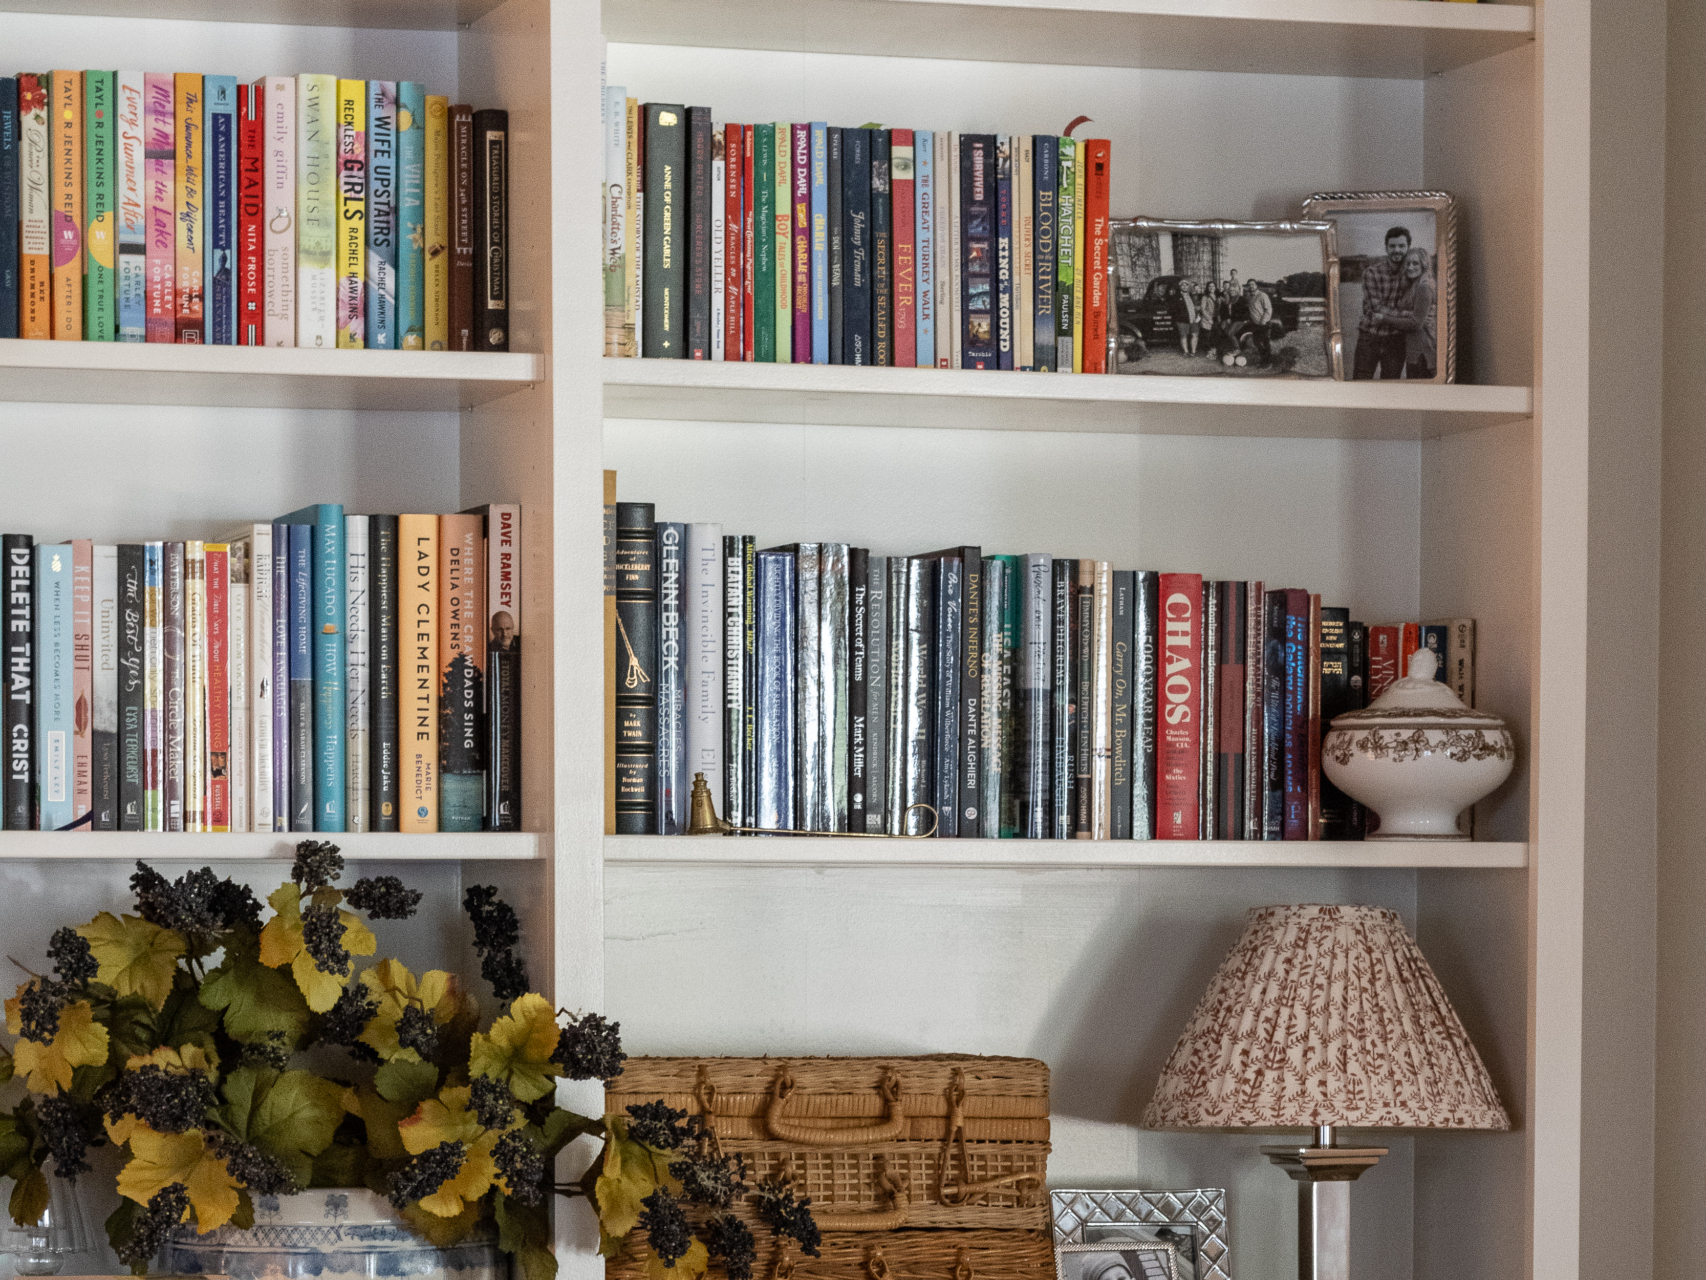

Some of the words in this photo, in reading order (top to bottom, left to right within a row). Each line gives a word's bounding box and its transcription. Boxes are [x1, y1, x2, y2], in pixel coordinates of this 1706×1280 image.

[120, 85, 140, 130] Every
[306, 84, 319, 142] SWAN
[374, 92, 384, 109] THE
[274, 103, 288, 144] emily
[343, 99, 354, 154] RECKLESS
[374, 116, 391, 158] WIFE
[778, 127, 786, 157] ROALD
[123, 132, 142, 194] Summer
[798, 131, 806, 164] ROALD
[815, 130, 823, 158] ROALD
[244, 157, 259, 217] MAID
[274, 150, 288, 190] giffin
[343, 159, 364, 221] GIRLS
[664, 165, 672, 189] ANNE
[778, 161, 786, 187] DAHL
[798, 168, 806, 196] DAHL
[815, 162, 823, 186] DAHL
[921, 174, 929, 188] THE
[306, 155, 320, 227] HOUSE
[373, 166, 390, 248] UPSTAIRS
[664, 191, 671, 204] OF
[124, 196, 143, 234] After
[713, 219, 723, 245] OLD
[850, 209, 865, 245] Johnny
[921, 192, 930, 233] GREAT
[1039, 191, 1053, 252] BLOOD
[1060, 195, 1072, 267] HATCHET
[1094, 218, 1104, 236] The
[248, 225, 256, 252] NITA
[348, 227, 358, 268] RACHEL
[663, 237, 671, 268] GABLES
[797, 236, 807, 273] CHARLIE
[999, 237, 1009, 280] KING
[1093, 238, 1103, 269] Secret
[248, 256, 256, 294] PROSE
[378, 261, 386, 291] RACHEL
[713, 249, 724, 294] YELLER
[853, 247, 864, 287] Tremain
[877, 239, 886, 279] SECRET
[898, 244, 912, 307] FEVER
[922, 238, 930, 286] TURKEY
[153, 259, 161, 314] FORTUNE
[164, 264, 172, 309] CARLEY
[266, 249, 278, 317] borrowed
[279, 246, 292, 321] something
[348, 272, 358, 320] HAWKINS
[1038, 262, 1052, 315] RIVER
[1093, 272, 1102, 307] Garden
[66, 318, 72, 331] DO
[378, 294, 386, 330] HAWKINS
[897, 308, 906, 329] 1793
[922, 290, 930, 321] WALK
[999, 293, 1009, 352] MOUND
[1061, 294, 1069, 330] PAULSEN
[324, 524, 335, 553] MAX
[380, 528, 391, 553] The
[500, 512, 512, 547] DAVE
[349, 552, 366, 583] His
[417, 537, 430, 593] LADY
[450, 547, 460, 591] DELIA
[464, 532, 474, 585] WHERE
[661, 529, 679, 605] GLENN
[701, 542, 716, 575] The
[10, 548, 30, 632] DELETE
[53, 581, 61, 611] WHEN
[170, 553, 179, 616] BATTERSON
[324, 560, 335, 616] LUCADO
[378, 557, 391, 612] Happiest
[500, 552, 512, 608] RAMSEY
[727, 557, 742, 615] BLATANT
[855, 585, 865, 605] The
[968, 574, 978, 624] DANTE'S
[53, 615, 61, 638] LESS
[347, 589, 366, 645] Needs,
[380, 615, 391, 642] Man
[450, 596, 460, 650] OWENS
[464, 592, 474, 627] THE
[701, 583, 716, 663] Invincible
[773, 599, 781, 636] DIVIDING
[854, 606, 865, 637] Secret
[100, 598, 114, 671] Uninvited
[380, 645, 388, 660] on
[662, 612, 679, 672] BECK
[773, 638, 781, 653] THE
[855, 638, 865, 648] of
[967, 627, 977, 678] INFERNO
[10, 643, 31, 704] THAT
[53, 642, 61, 690] BECOMES
[349, 650, 366, 683] Her
[416, 603, 430, 742] CLEMENTINE
[464, 631, 474, 708] CRAWDADS
[727, 617, 742, 710] CHRISTIANITY
[773, 656, 781, 678] BOOK
[854, 648, 864, 681] Teams
[1113, 641, 1127, 675] Carry
[1164, 593, 1192, 723] CHAOS
[213, 664, 222, 709] HEALTHY
[380, 664, 391, 699] Earth
[698, 670, 716, 724] Family
[773, 680, 781, 691] OF
[1113, 679, 1127, 699] On,
[53, 693, 61, 722] MORE
[125, 706, 138, 730] LYSA
[168, 687, 181, 730] Circle
[349, 688, 366, 740] Needs
[968, 698, 976, 735] DANTE
[1114, 703, 1126, 725] Mr.
[213, 713, 222, 749] LIVING
[464, 712, 474, 749] SING
[854, 716, 864, 744] Mark
[11, 723, 29, 783] CRIST
[125, 733, 139, 785] TERKEURST
[168, 733, 181, 782] Maker
[382, 742, 391, 768] Eddie
[854, 746, 864, 777] Miller
[967, 738, 976, 789] ALIGHIERI
[1114, 729, 1126, 786] Bowditch
[76, 755, 88, 796] EHMAN
[381, 769, 391, 791] Jaku
[415, 753, 423, 801] BENEDICT
